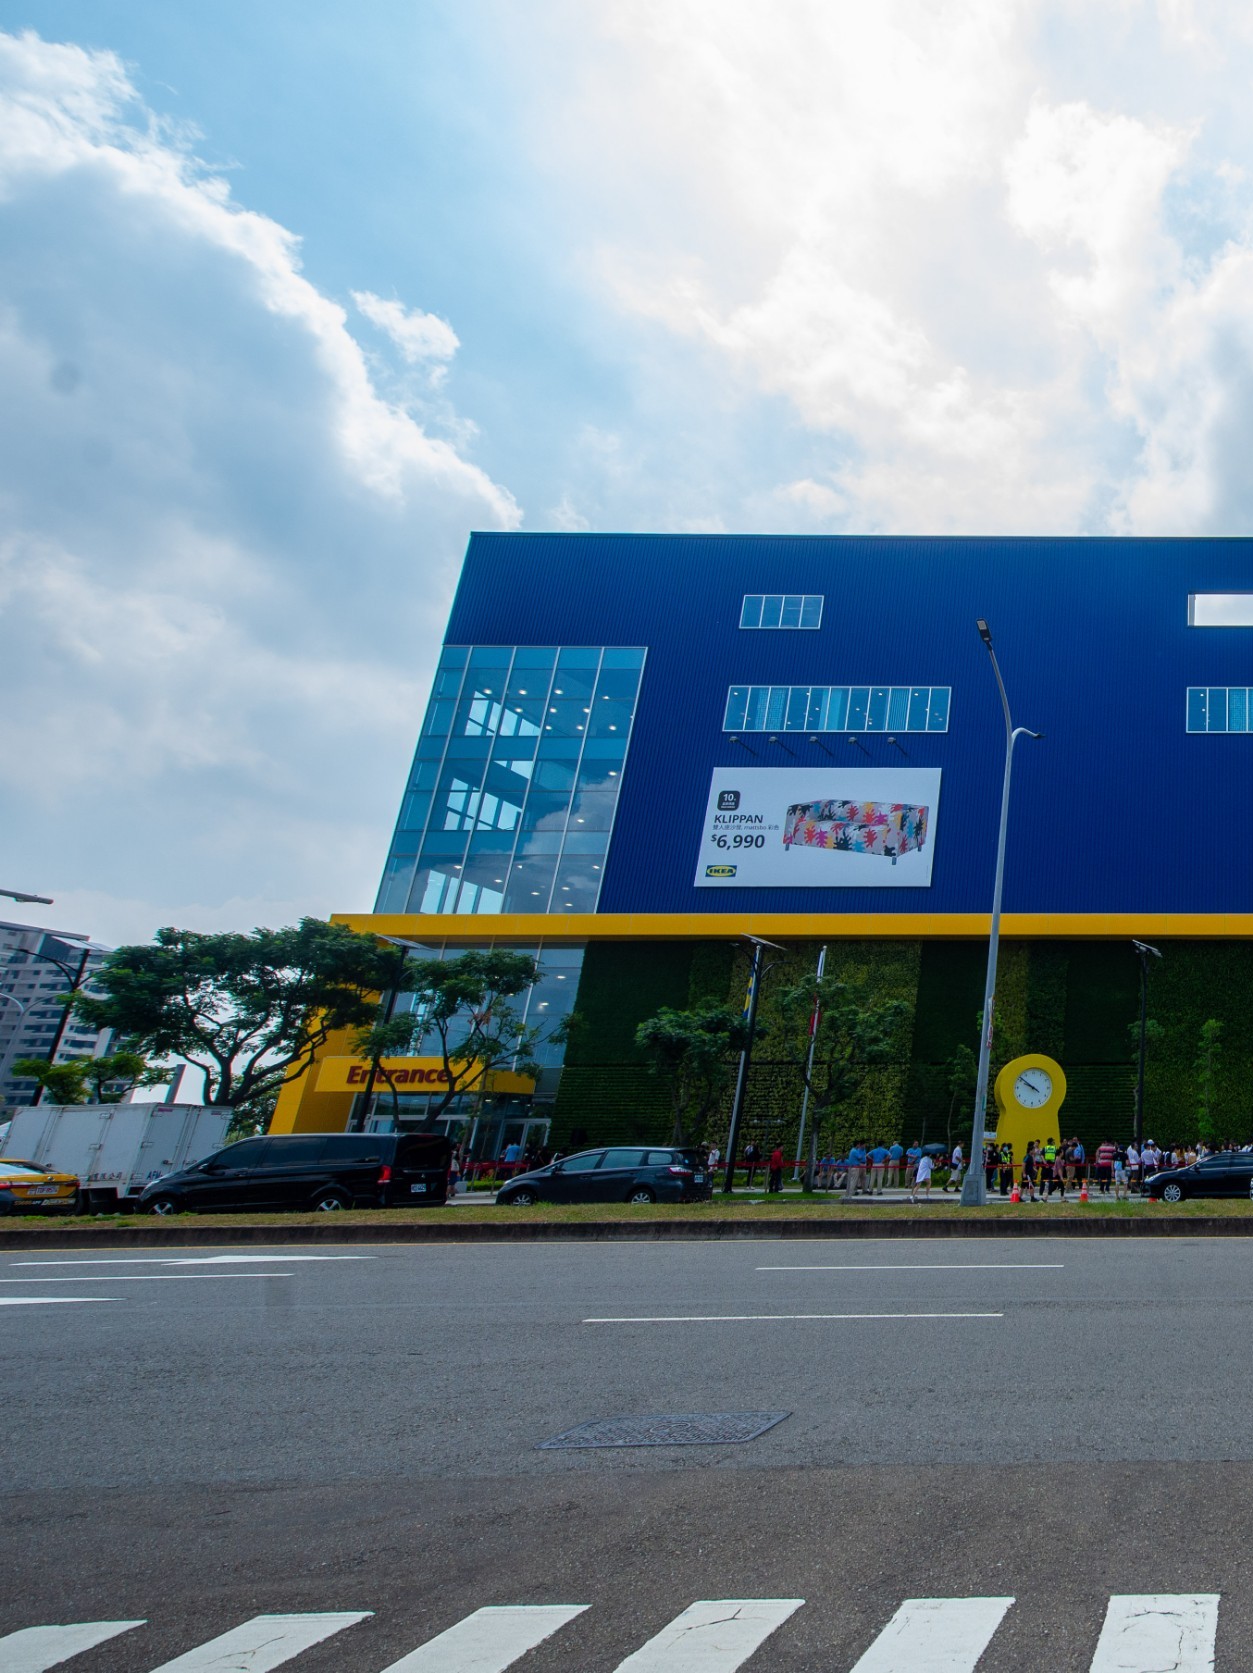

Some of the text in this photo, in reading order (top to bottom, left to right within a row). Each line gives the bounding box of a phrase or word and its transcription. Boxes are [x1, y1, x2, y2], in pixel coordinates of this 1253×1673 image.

[714, 814, 764, 823] KLIPPAN
[710, 834, 765, 850] $6,990
[347, 1066, 453, 1084] Entrance
